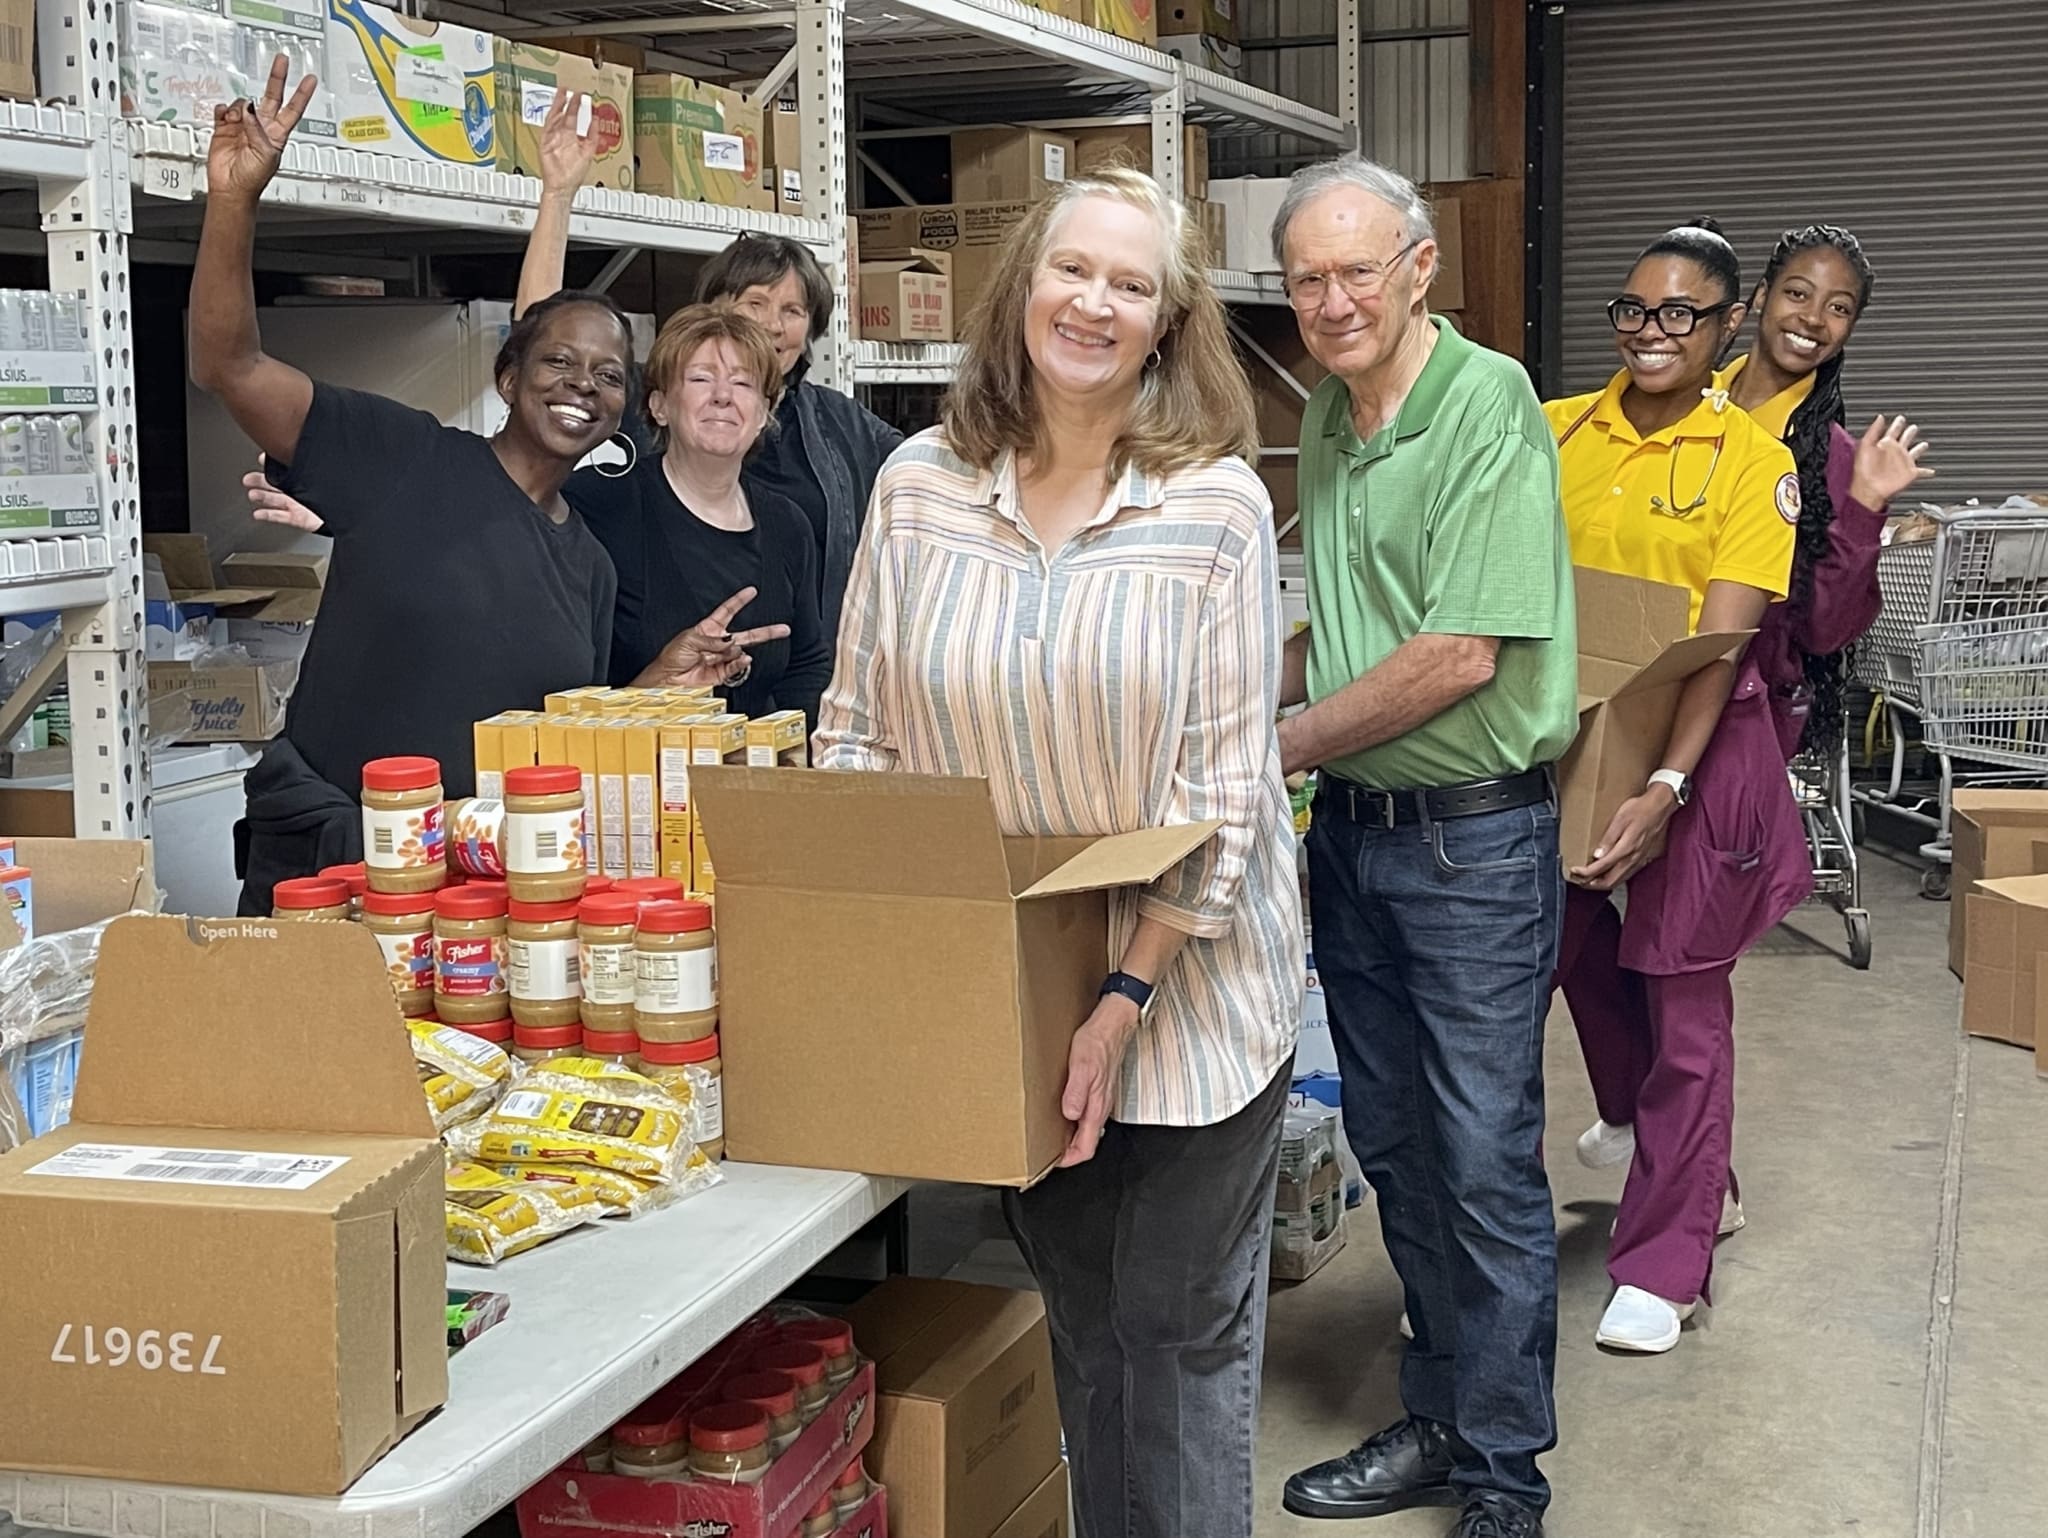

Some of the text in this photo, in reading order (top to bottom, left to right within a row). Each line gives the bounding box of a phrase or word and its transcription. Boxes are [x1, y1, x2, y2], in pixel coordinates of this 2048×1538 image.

[161, 168, 180, 189] 9B
[341, 188, 367, 203] Drinks
[923, 215, 954, 224] USDA
[924, 227, 955, 236] FOOD
[190, 696, 245, 718] Totally
[191, 715, 237, 731] Juice
[200, 923, 278, 942] Open Here
[446, 943, 487, 965] Fisher
[51, 1323, 227, 1375] 739617
